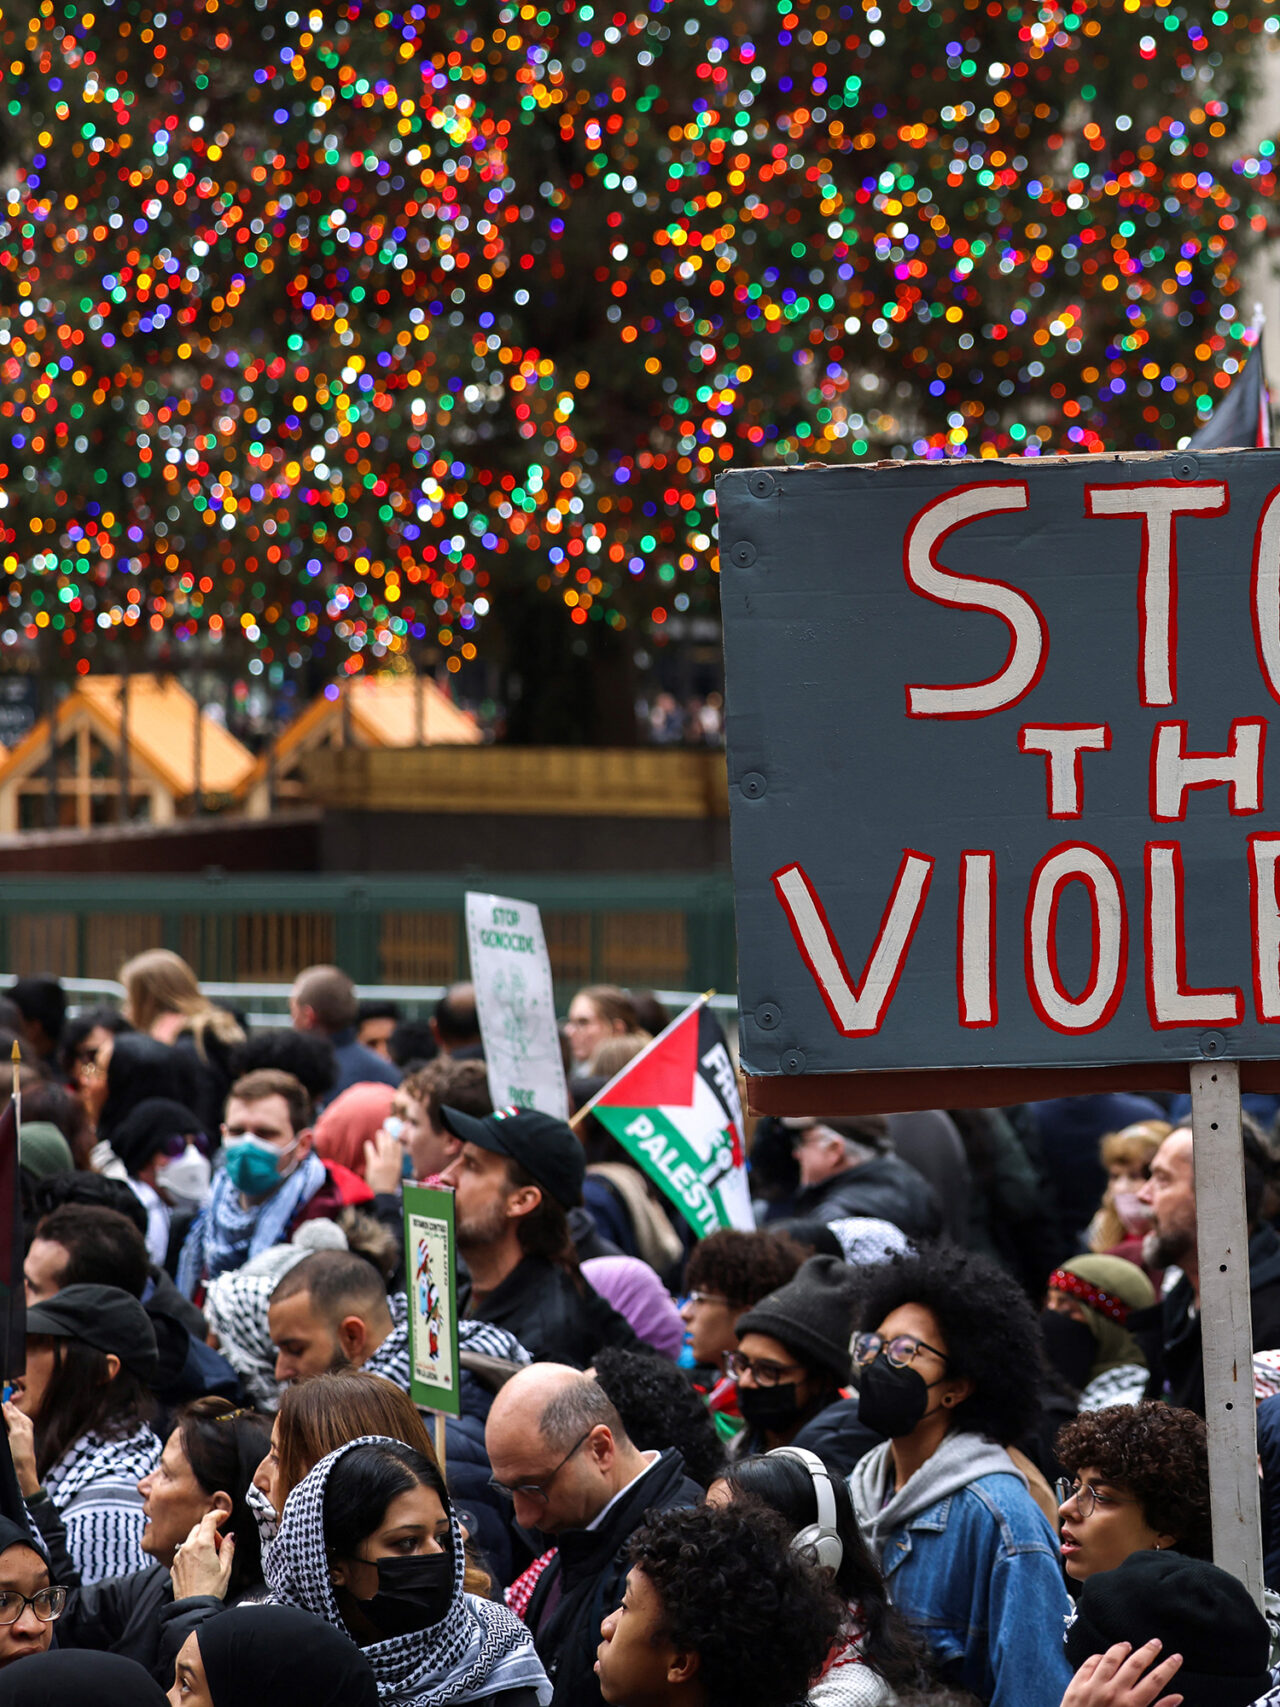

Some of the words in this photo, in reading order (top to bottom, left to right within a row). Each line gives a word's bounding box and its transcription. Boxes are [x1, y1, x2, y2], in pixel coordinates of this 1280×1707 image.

[492, 907, 520, 927] STOP
[480, 929, 536, 955] GENOCIDE
[625, 1113, 720, 1235] PALESTI
